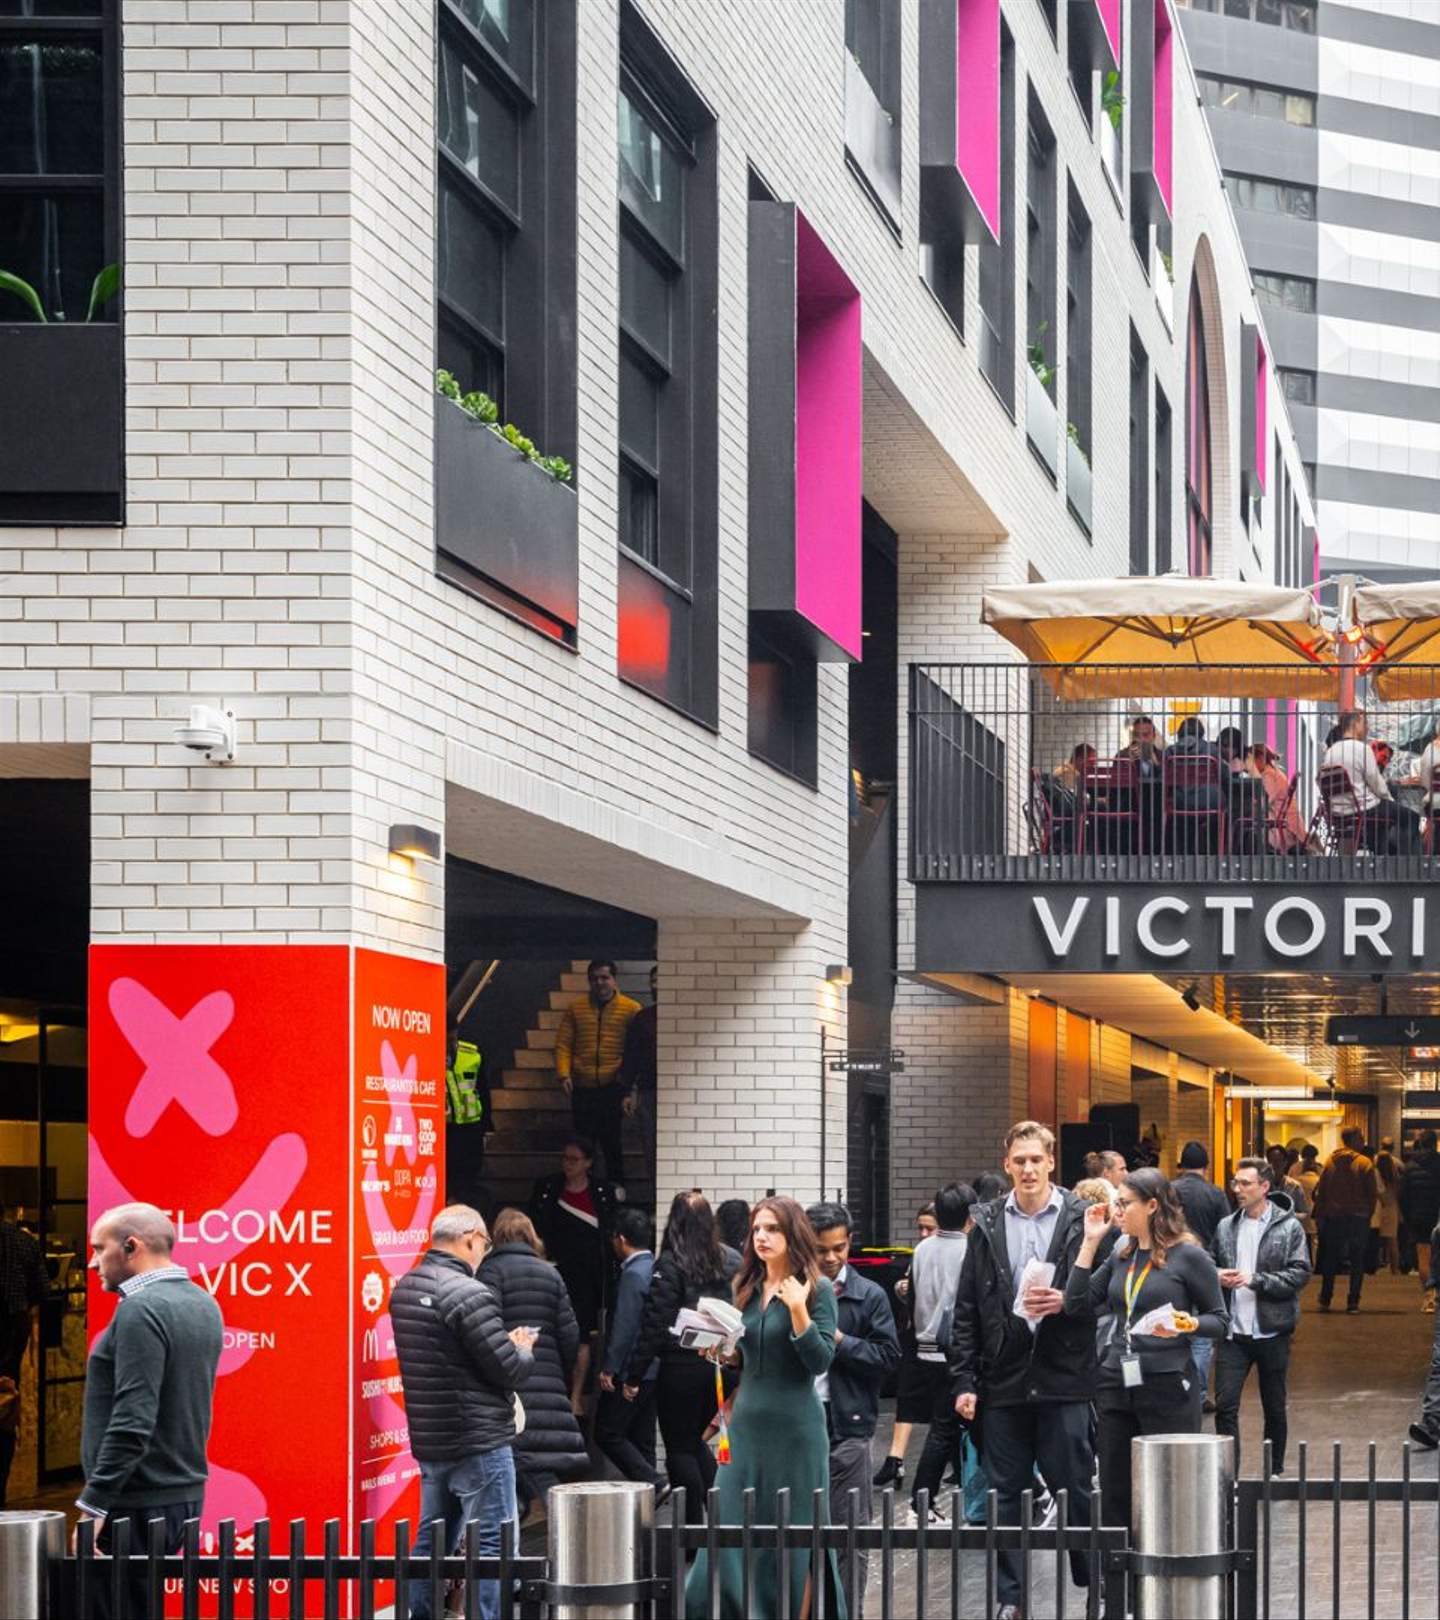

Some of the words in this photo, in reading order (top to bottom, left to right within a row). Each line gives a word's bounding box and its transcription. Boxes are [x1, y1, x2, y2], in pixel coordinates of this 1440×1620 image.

[373, 1004, 400, 1030] NOW
[403, 1008, 431, 1035] OPEN
[163, 1209, 333, 1244] LCOME
[410, 1228, 430, 1244] FOOD
[197, 1261, 273, 1297] VIC
[283, 1262, 313, 1297] X
[222, 1331, 276, 1349] OPEN
[369, 1430, 394, 1449] SHOPS
